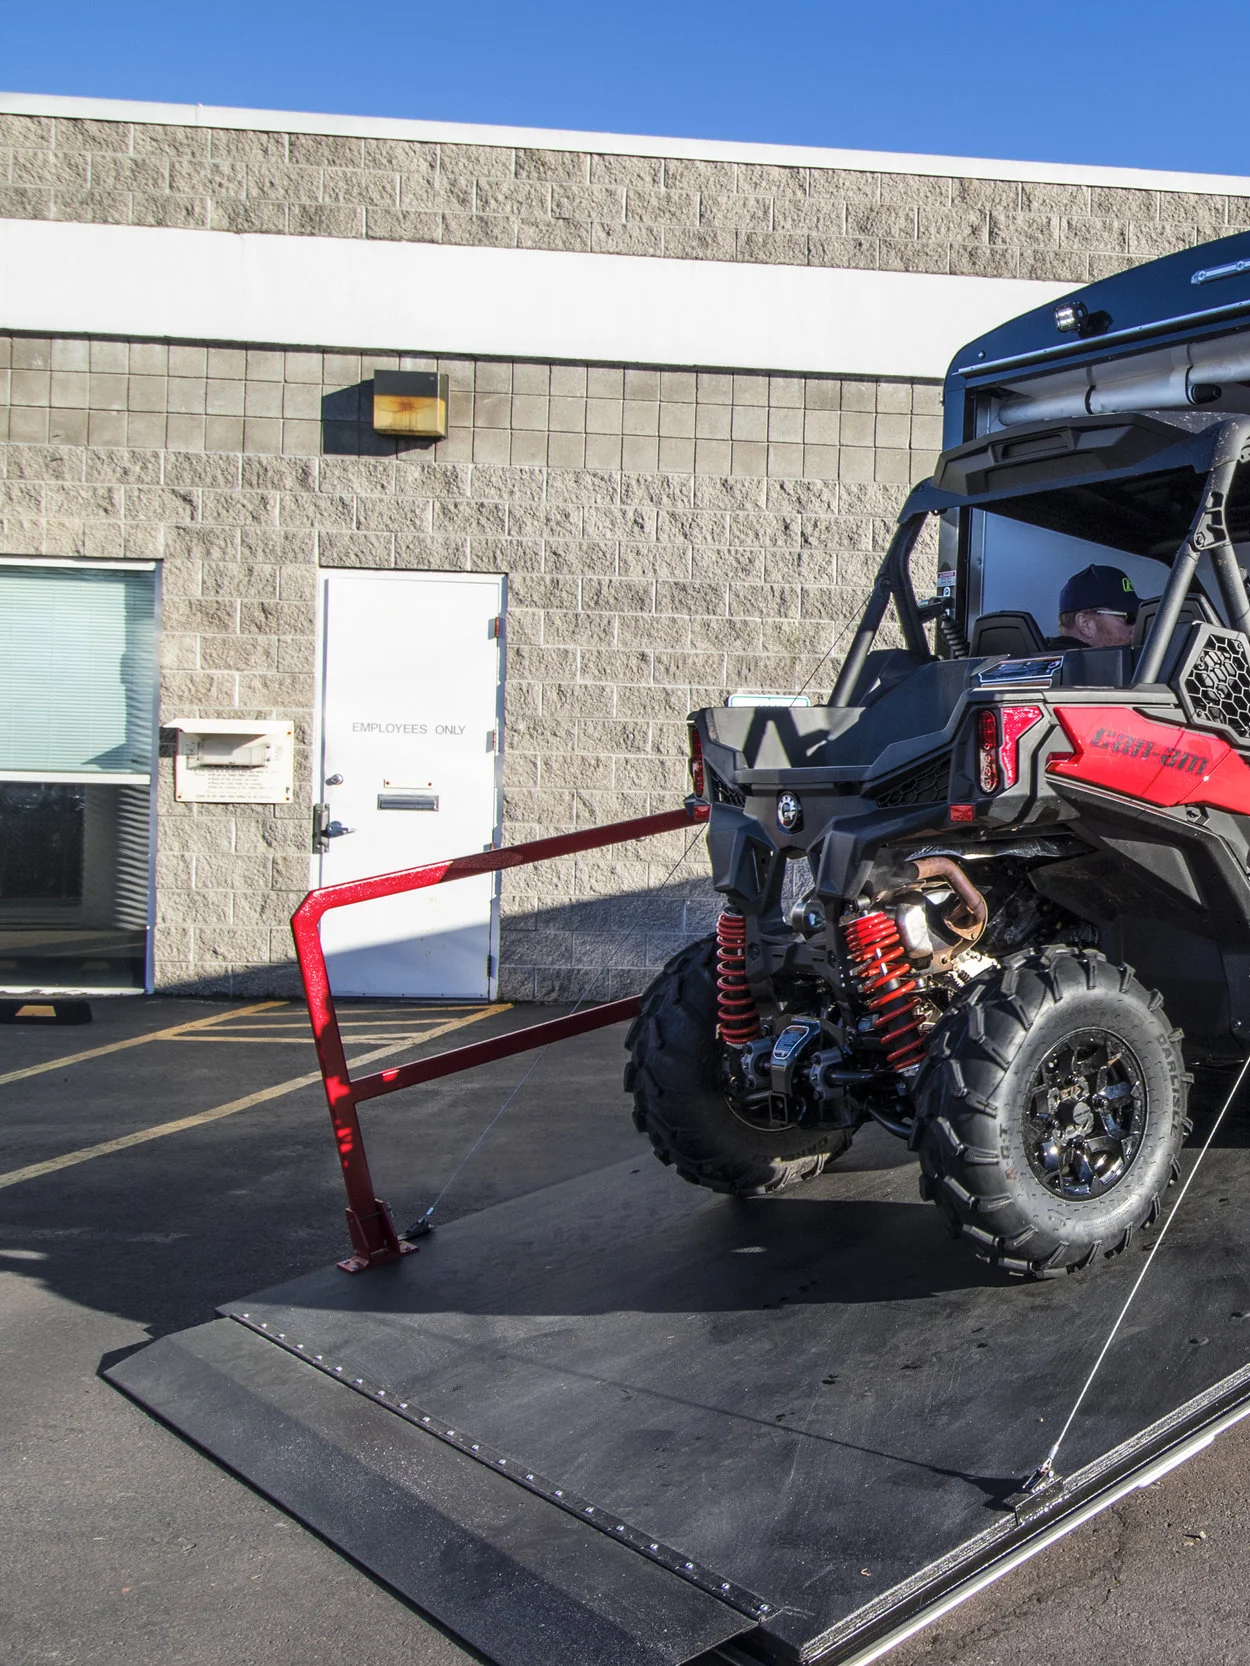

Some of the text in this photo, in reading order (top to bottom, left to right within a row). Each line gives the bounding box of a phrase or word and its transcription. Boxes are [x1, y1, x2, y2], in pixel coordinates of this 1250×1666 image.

[352, 722, 466, 736] EMPLOYEES ONLY
[1156, 1033, 1181, 1137] CARLISLE
